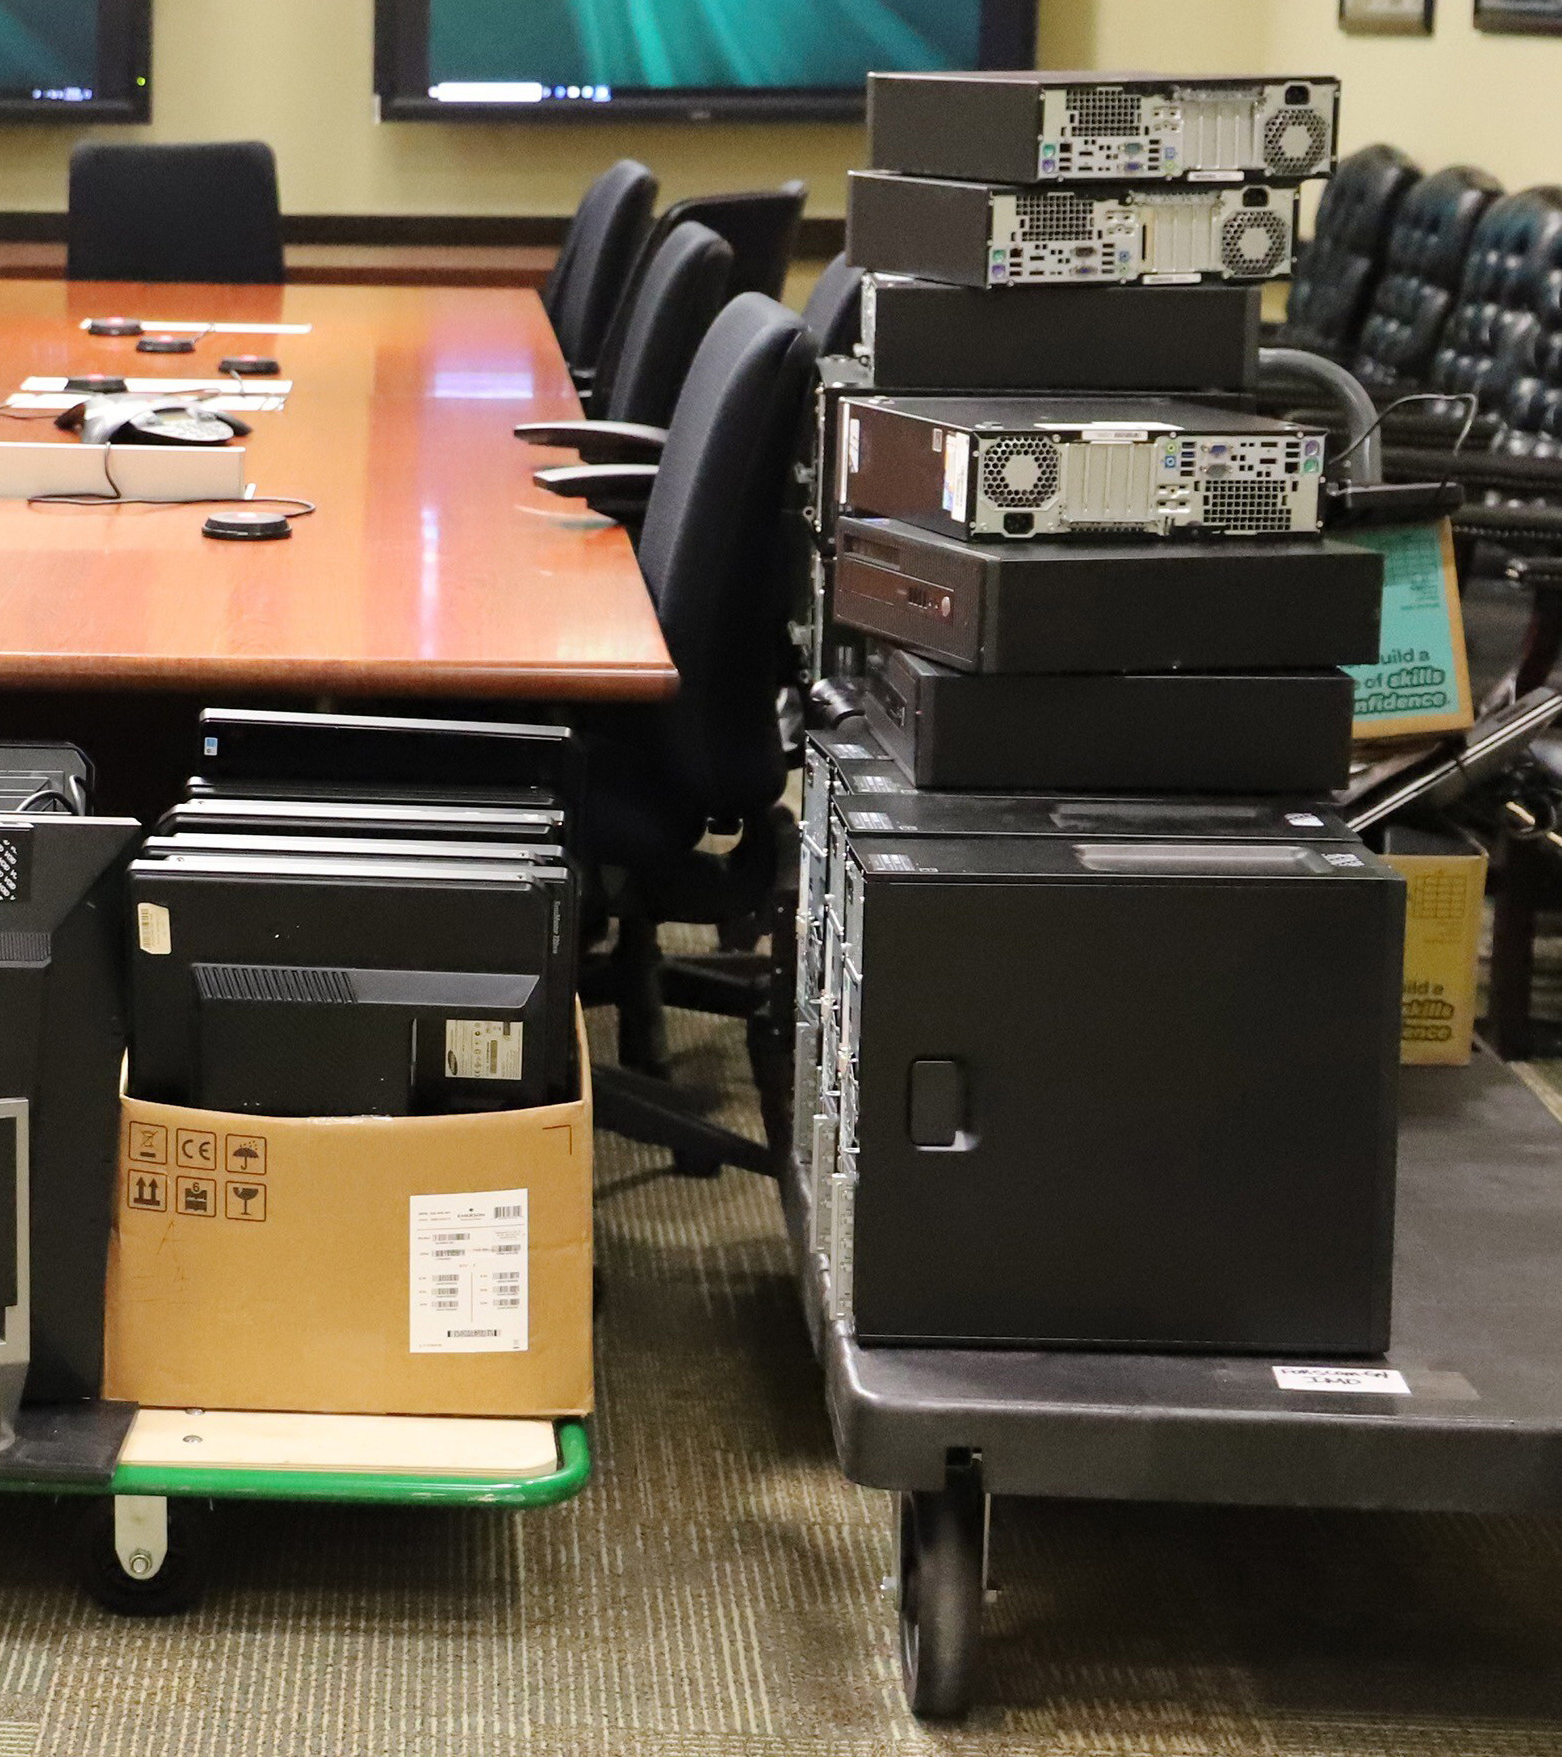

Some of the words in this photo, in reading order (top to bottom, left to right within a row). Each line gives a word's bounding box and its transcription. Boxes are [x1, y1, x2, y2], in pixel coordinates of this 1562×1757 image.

[1381, 648, 1414, 664] uild
[1365, 673, 1383, 688] of
[1388, 666, 1446, 688] skills
[182, 1139, 211, 1160] CE
[192, 1182, 200, 1193] 6
